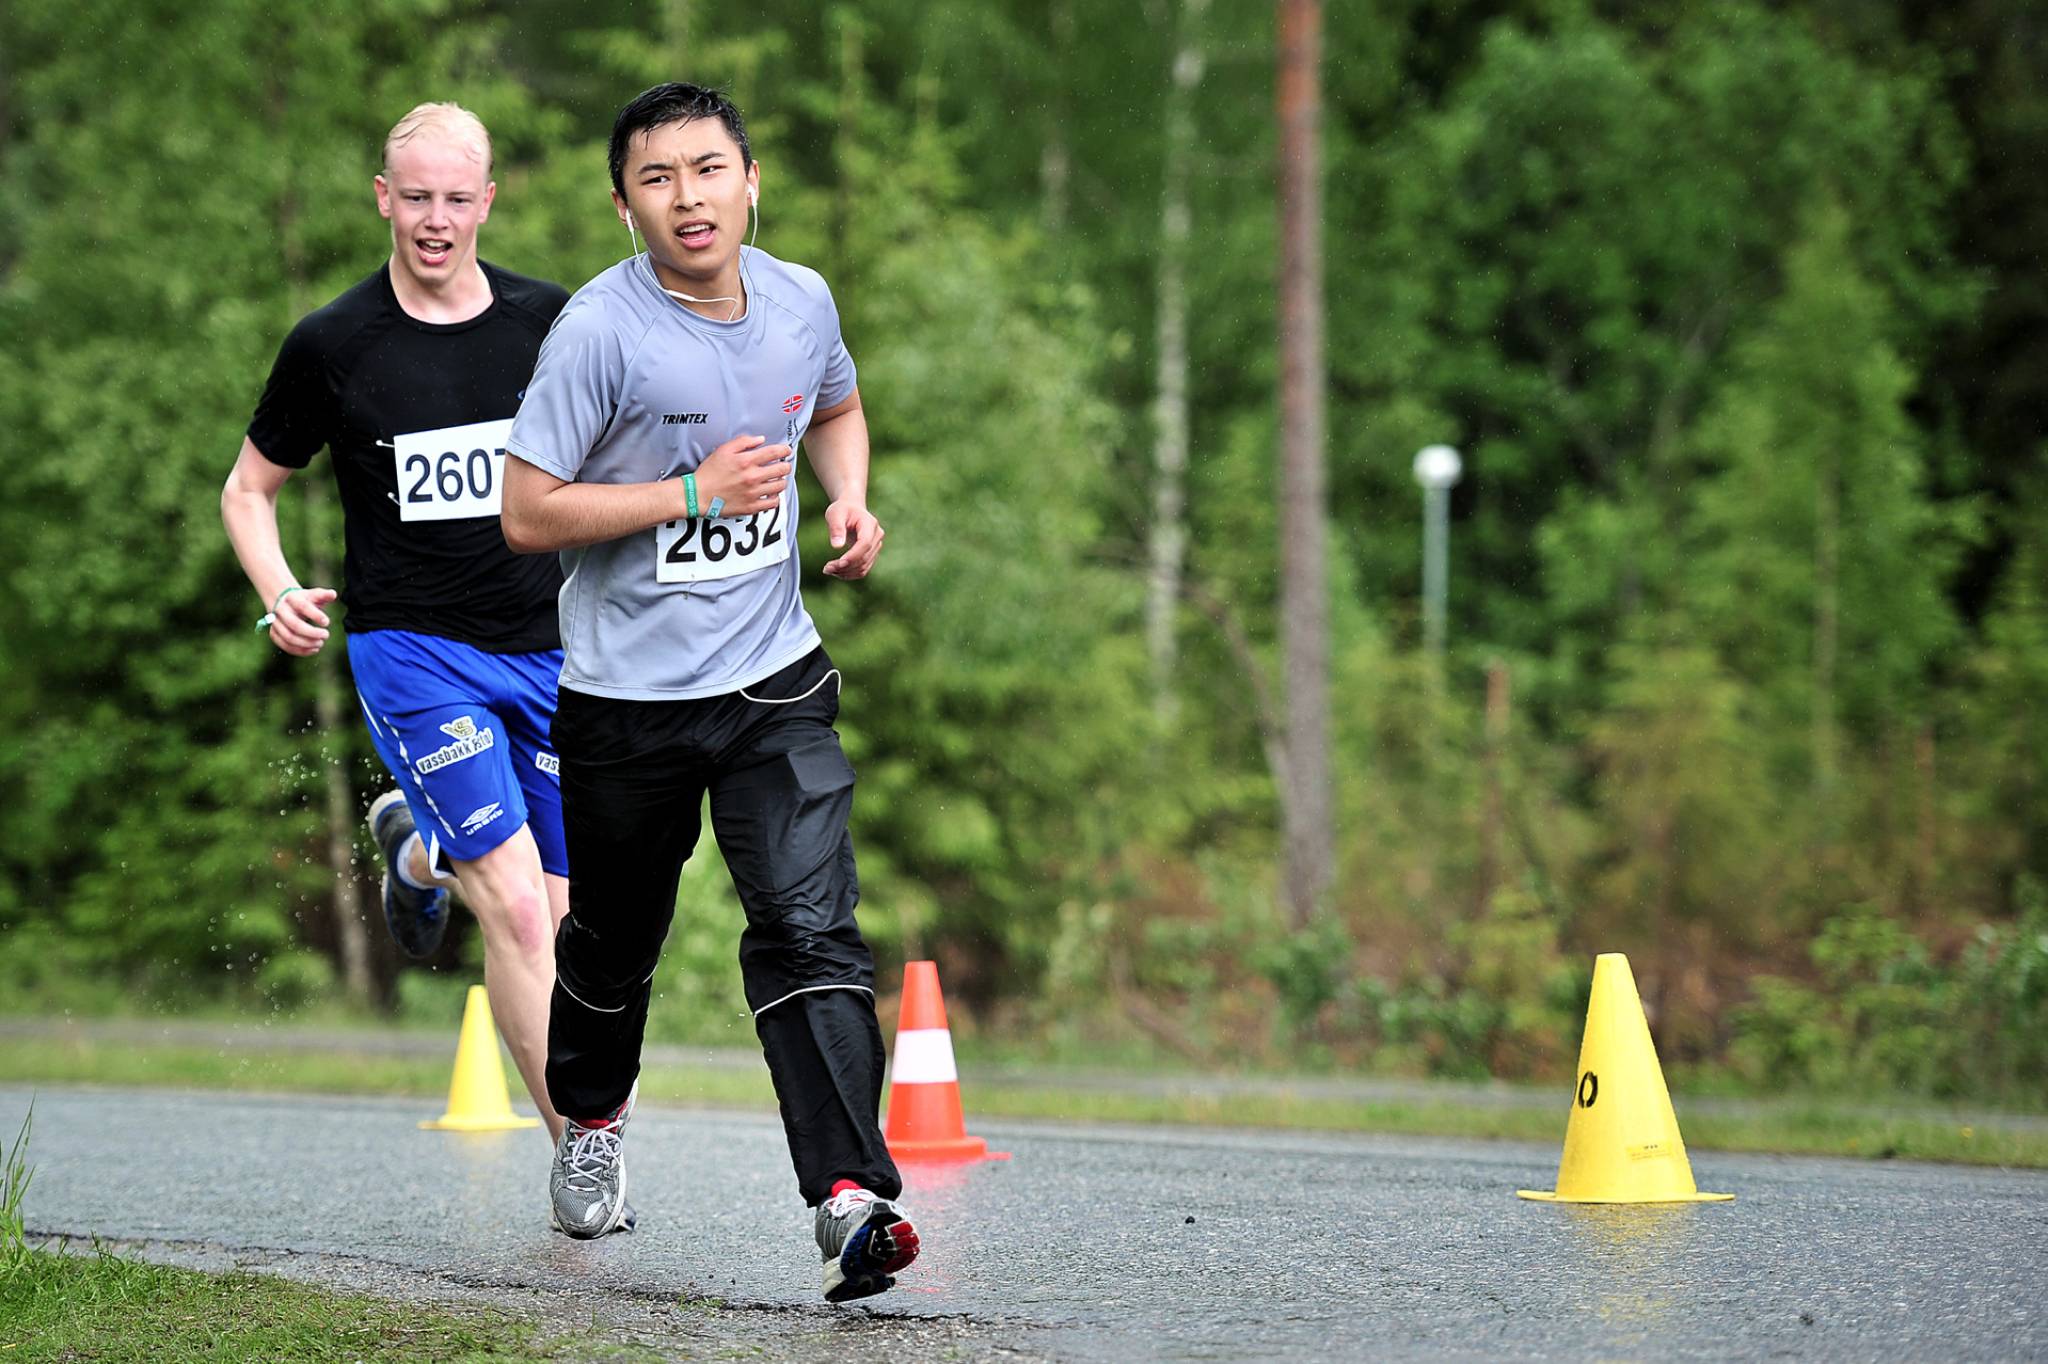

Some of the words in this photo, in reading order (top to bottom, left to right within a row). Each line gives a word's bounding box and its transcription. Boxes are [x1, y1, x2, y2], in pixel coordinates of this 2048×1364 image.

[662, 413, 708, 424] TRIMTEX
[405, 448, 506, 503] 260
[666, 502, 781, 563] 2632
